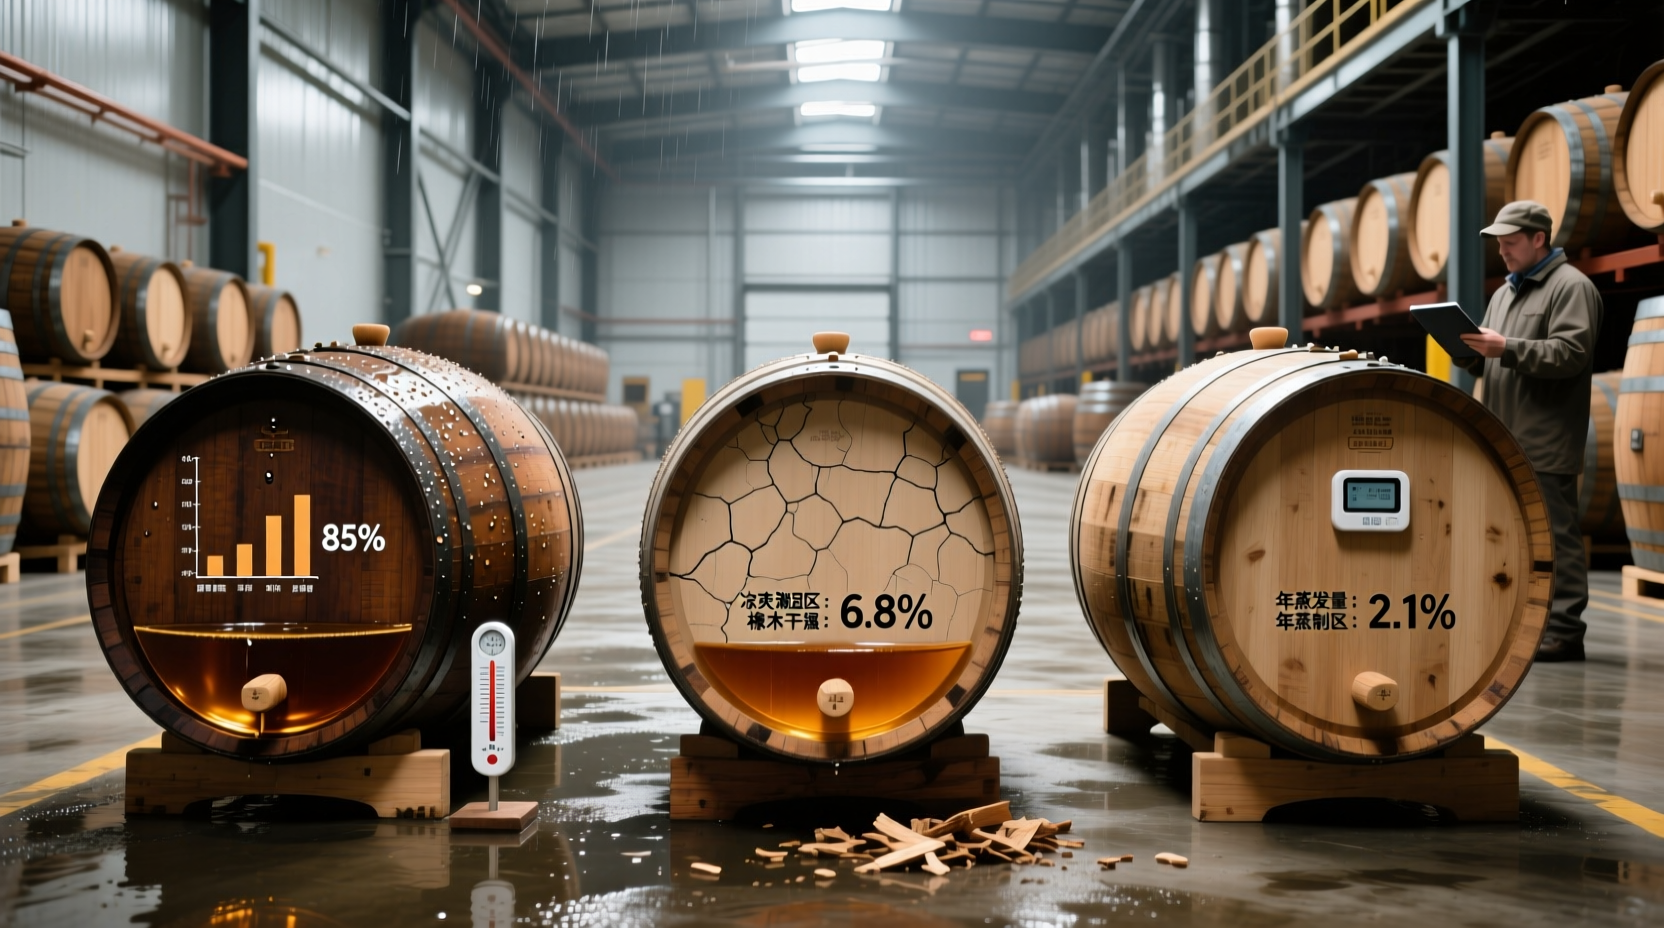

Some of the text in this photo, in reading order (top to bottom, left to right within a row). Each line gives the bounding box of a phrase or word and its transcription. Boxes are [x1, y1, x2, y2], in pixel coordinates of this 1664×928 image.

[321, 523, 386, 552] 85%
[840, 593, 933, 630] 6.8%
[1368, 593, 1456, 630] 2.1%
